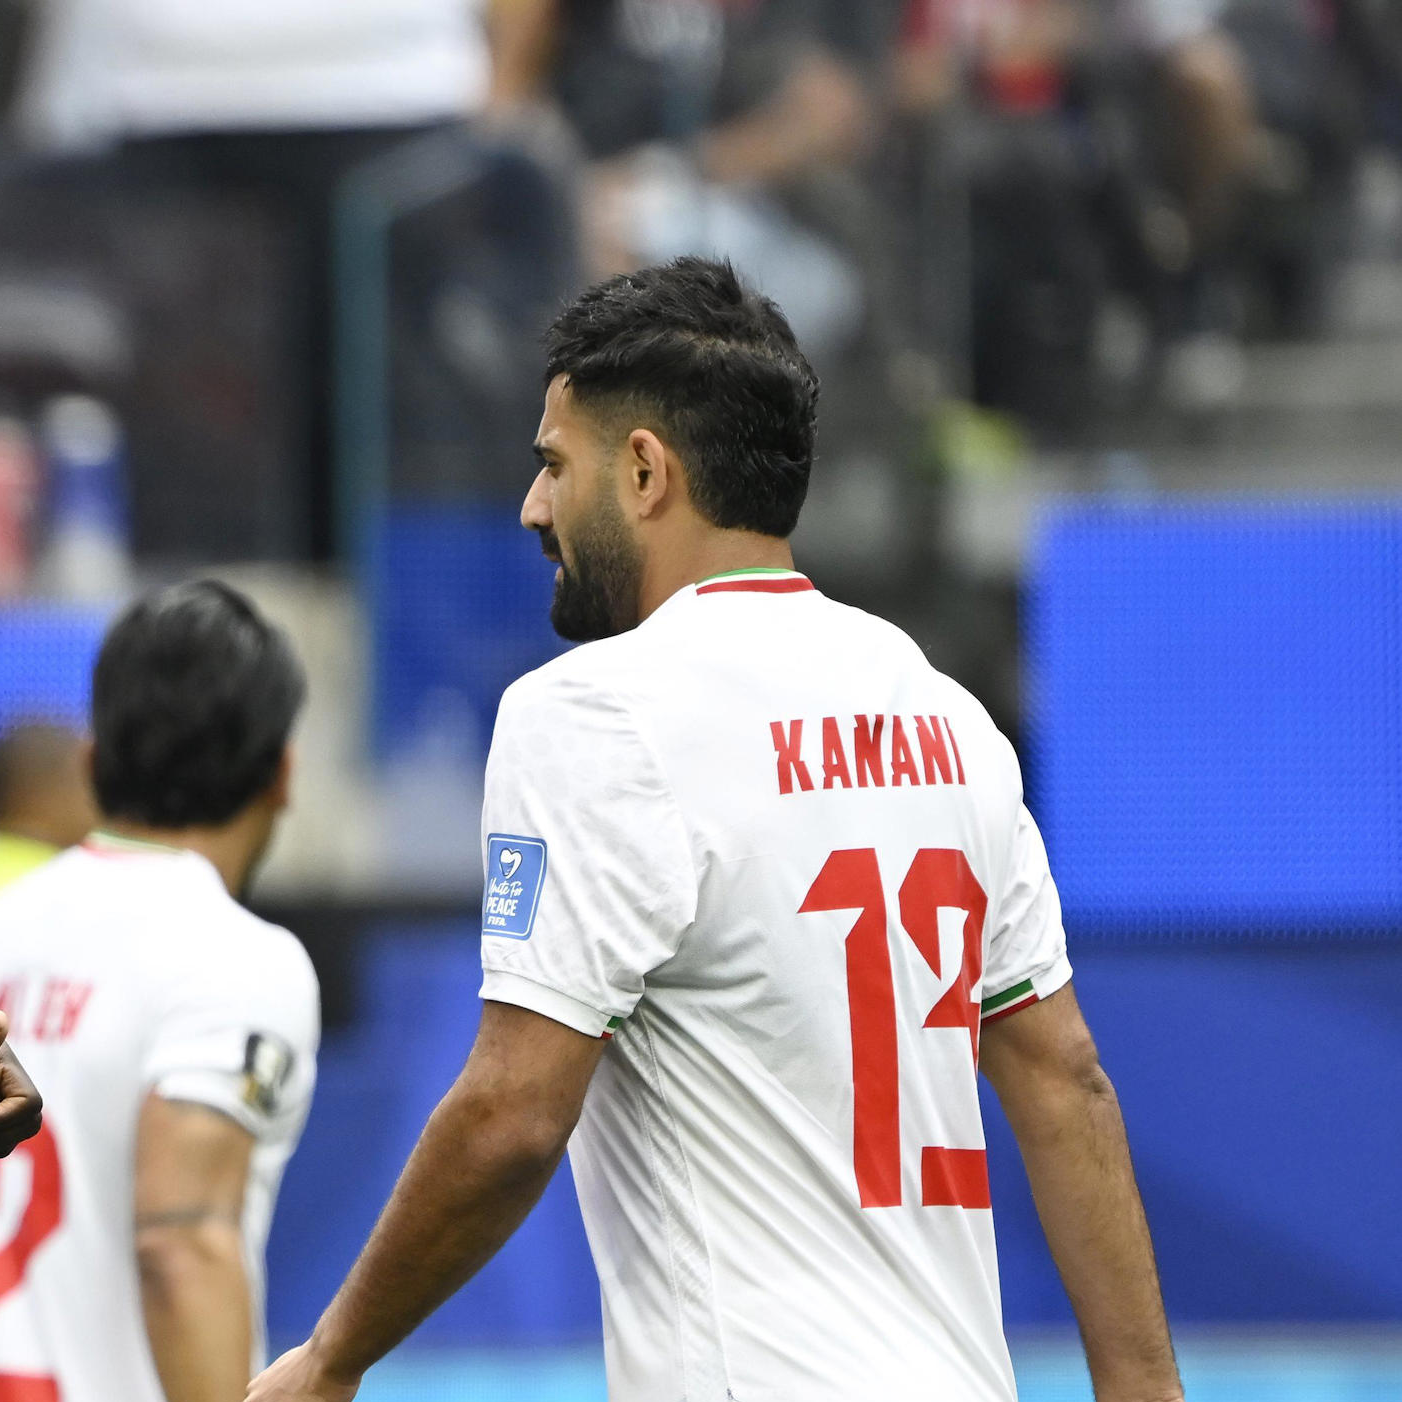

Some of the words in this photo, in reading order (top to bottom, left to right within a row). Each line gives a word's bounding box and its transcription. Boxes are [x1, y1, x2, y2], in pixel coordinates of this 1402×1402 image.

[769, 713, 966, 795] KANANI
[509, 880, 523, 897] For
[486, 896, 519, 917] PEACE
[487, 916, 507, 926] FIFA
